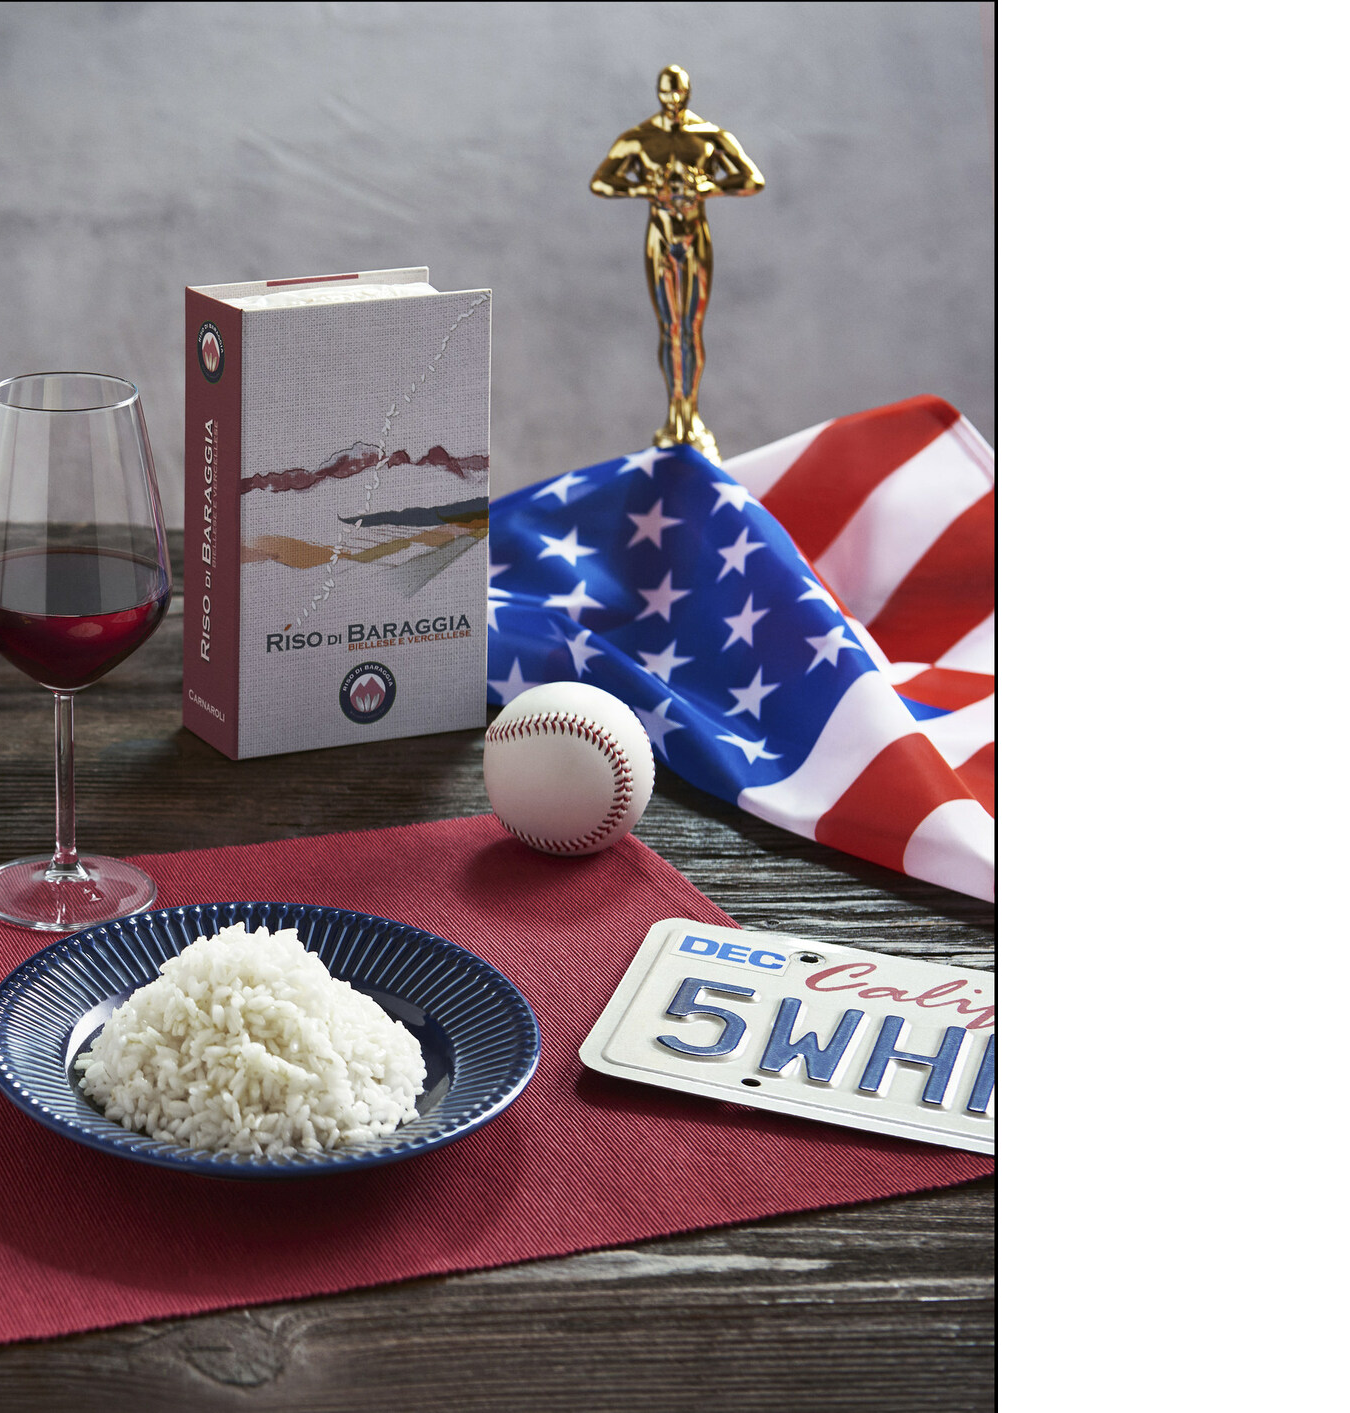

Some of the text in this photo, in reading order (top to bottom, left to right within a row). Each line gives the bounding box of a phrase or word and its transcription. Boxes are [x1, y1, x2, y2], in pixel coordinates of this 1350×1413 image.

[200, 418, 214, 662] RISO DI BARAGGIA
[266, 614, 471, 653] RISO DI BARAGGIA
[348, 630, 472, 651] BIELLESE E VERCELLESE
[342, 664, 394, 692] RISO DI BARAGGIA
[188, 689, 226, 723] CARNAROLI
[678, 935, 787, 970] DEC
